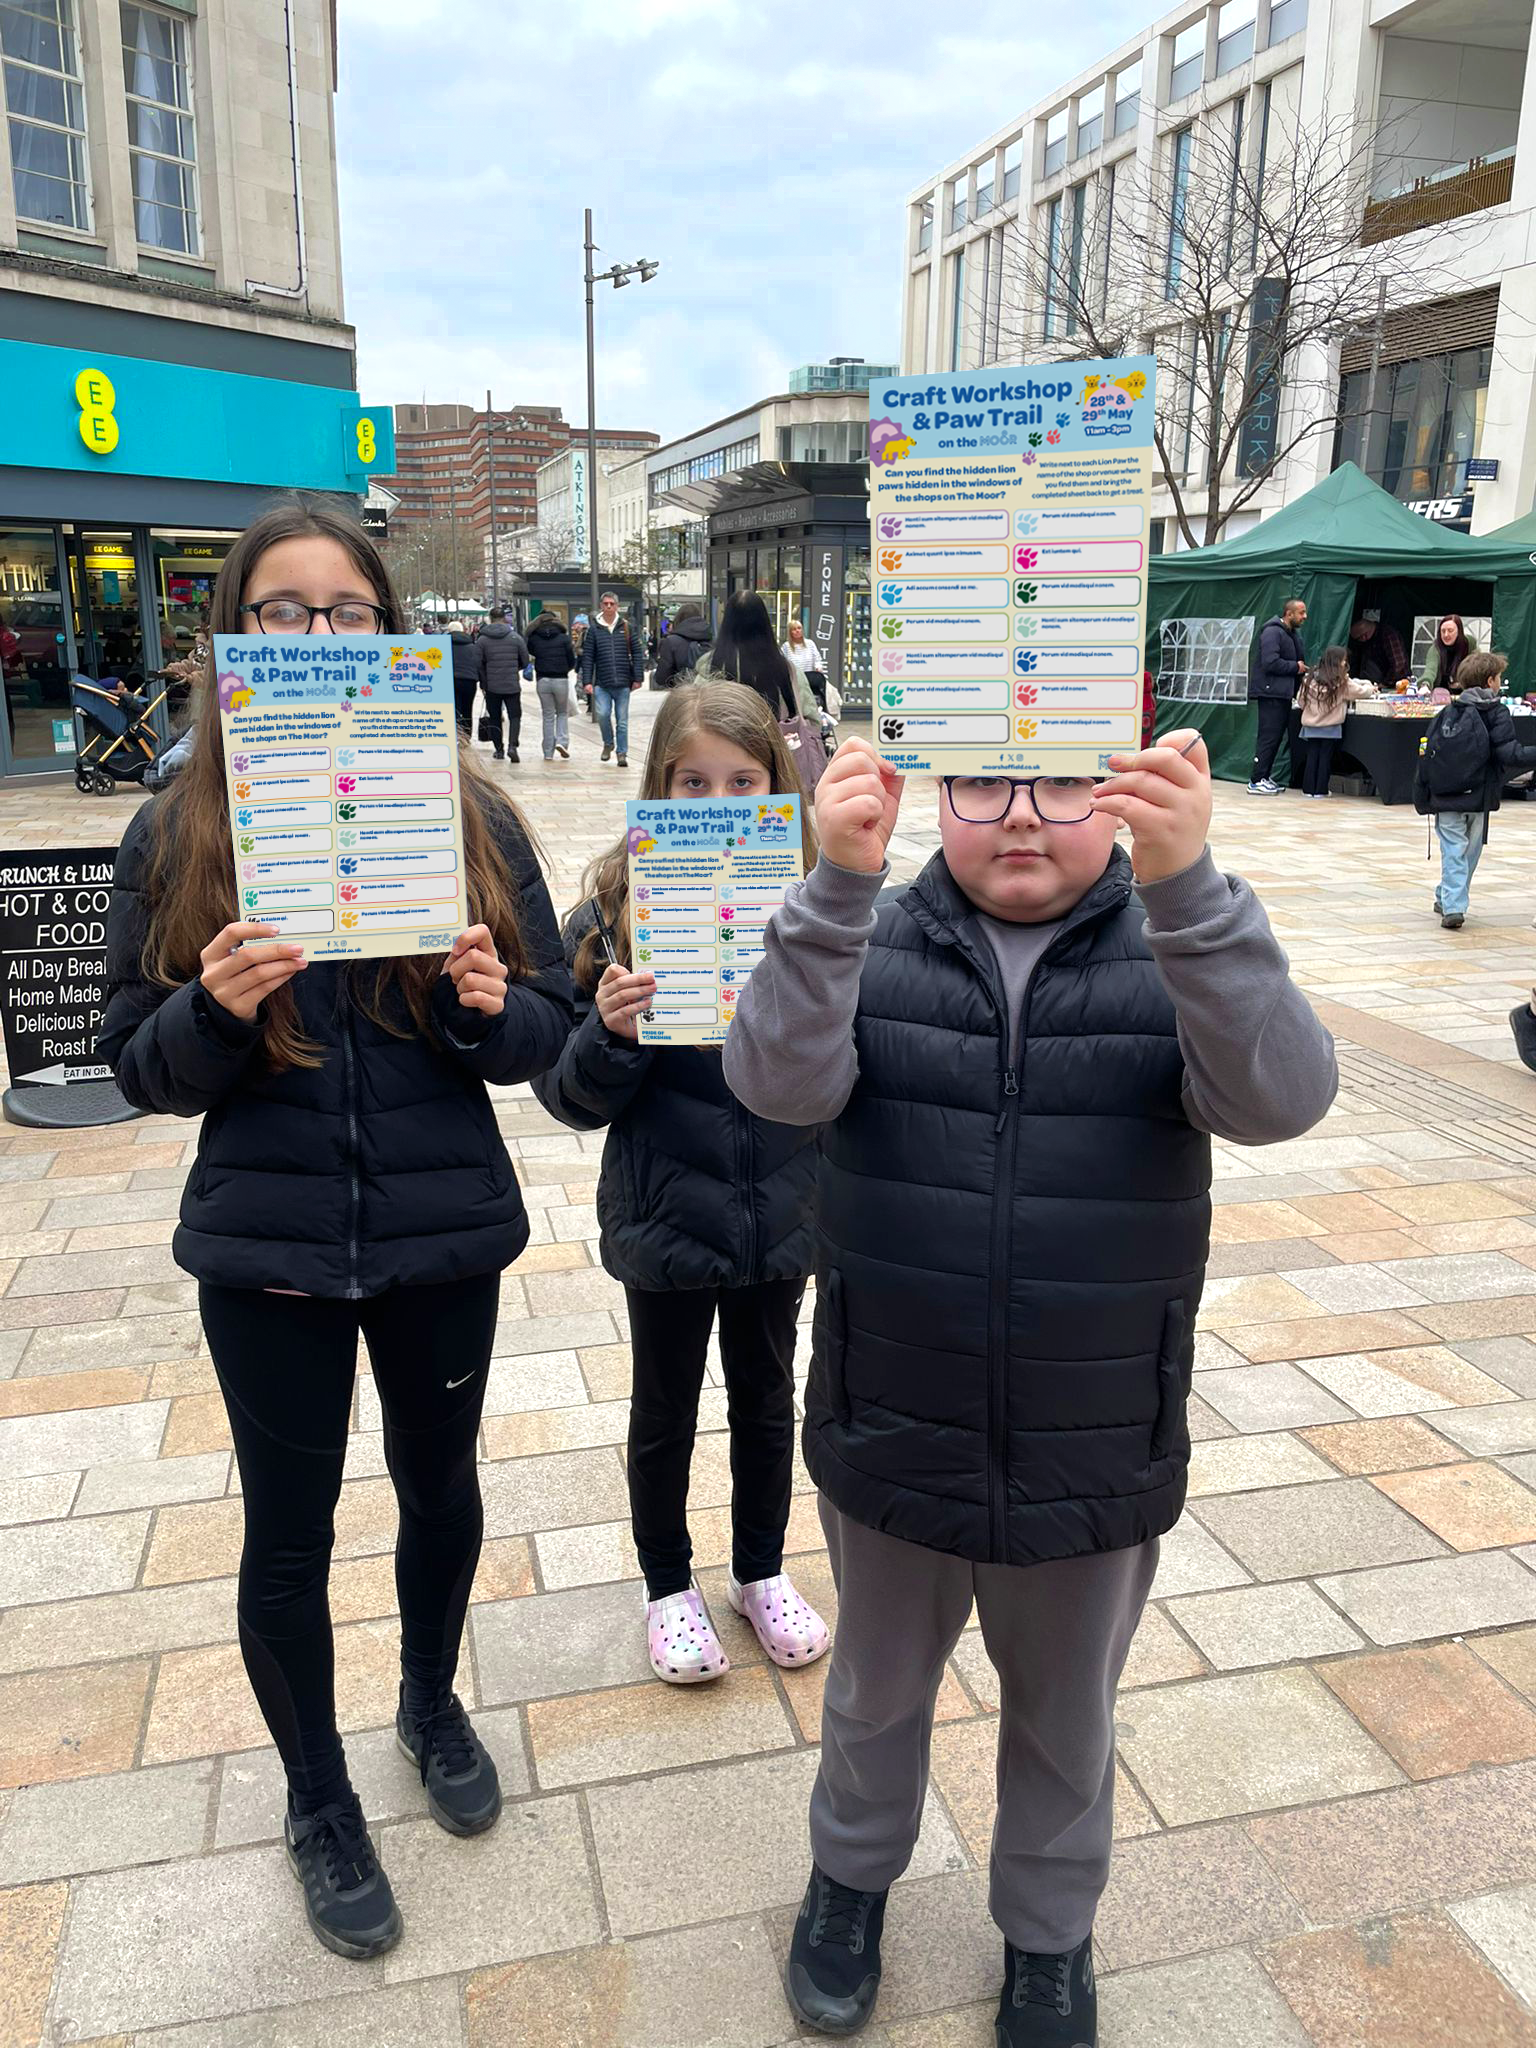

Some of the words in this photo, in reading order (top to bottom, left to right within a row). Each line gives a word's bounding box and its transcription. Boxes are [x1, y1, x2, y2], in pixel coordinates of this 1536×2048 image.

[883, 385, 947, 408] Craft
[950, 379, 1073, 404] Workshop
[1090, 394, 1115, 407] 28th
[1116, 394, 1126, 405] &
[912, 412, 931, 431] &
[934, 411, 985, 430] Paw
[987, 403, 1042, 427] Trail
[1081, 409, 1106, 422] 29th
[1108, 408, 1133, 421] May
[938, 439, 954, 448] on
[956, 437, 978, 448] the
[1039, 461, 1058, 469] Write
[1059, 460, 1073, 468] next
[1082, 459, 1098, 467] each
[1098, 458, 1112, 466] Lion
[1112, 457, 1127, 465] Paw
[1127, 456, 1139, 464] the
[885, 469, 904, 478] Can
[905, 469, 923, 478] you
[924, 467, 944, 476] find
[945, 467, 962, 476] the
[963, 465, 997, 475] hidden
[998, 464, 1016, 473] lion
[1056, 470, 1064, 478] of
[1063, 470, 1074, 478] the
[1075, 469, 1092, 478] shop
[1120, 467, 1141, 475] where
[878, 481, 904, 492] paws
[905, 480, 939, 490] hidden
[940, 479, 950, 488] in
[951, 479, 967, 488] the
[968, 478, 1011, 487] windows
[1012, 476, 1023, 486] of
[1045, 481, 1058, 489] you
[1058, 480, 1072, 488] find
[1072, 479, 1090, 487] them
[1102, 478, 1120, 487] bring
[895, 493, 912, 503] the
[913, 493, 942, 503] shops
[943, 492, 956, 501] on
[956, 491, 975, 500] The
[975, 490, 1006, 500] Moor?
[1031, 490, 1067, 500] completed
[1067, 490, 1086, 498] sheet
[1086, 489, 1102, 497] back
[1110, 488, 1121, 498] get
[575, 459, 585, 557] ATKINSONS
[821, 552, 832, 607] FONE
[225, 646, 278, 663] Craft
[280, 646, 380, 666] Workshop
[820, 647, 829, 680] TE
[251, 667, 266, 683] &
[268, 667, 308, 682] Paw
[311, 665, 356, 682] Trail
[395, 662, 417, 671] 28th
[417, 662, 426, 671] &
[389, 672, 410, 681] 29th
[411, 673, 433, 683] May
[273, 689, 285, 698] on
[286, 687, 304, 698] the
[233, 716, 247, 724] Can
[247, 715, 262, 725] you
[263, 713, 278, 722] find
[278, 713, 292, 721] the
[292, 712, 320, 720] hidden
[320, 711, 336, 719] lion
[229, 726, 248, 736] paws
[248, 724, 275, 734] hidden
[275, 723, 284, 732] in
[283, 722, 297, 731] the
[297, 721, 332, 730] windows
[332, 721, 342, 729] of
[241, 735, 256, 744] the
[255, 734, 278, 743] shops
[287, 732, 303, 741] The
[303, 732, 329, 740] Moor?
[906, 754, 919, 762] OF
[636, 808, 676, 821] Craft
[678, 806, 752, 821] Workshop
[655, 823, 666, 835] &
[668, 822, 700, 835] Paw
[700, 819, 734, 834] Trail
[682, 838, 696, 847] the
[0, 865, 60, 886] RUNCH
[64, 865, 78, 884] &
[82, 863, 114, 882] LUN
[52, 892, 68, 915] &
[75, 890, 110, 913] CO
[36, 922, 105, 946] FOOD
[7, 960, 27, 980] All
[33, 959, 63, 982] Day
[9, 987, 55, 1007] Home
[60, 983, 101, 1004] Made
[16, 1012, 85, 1034] Delicious
[42, 1037, 86, 1058] Roast
[64, 1069, 81, 1078] EAT
[82, 1068, 91, 1077] IN
[93, 1067, 107, 1076] OR
